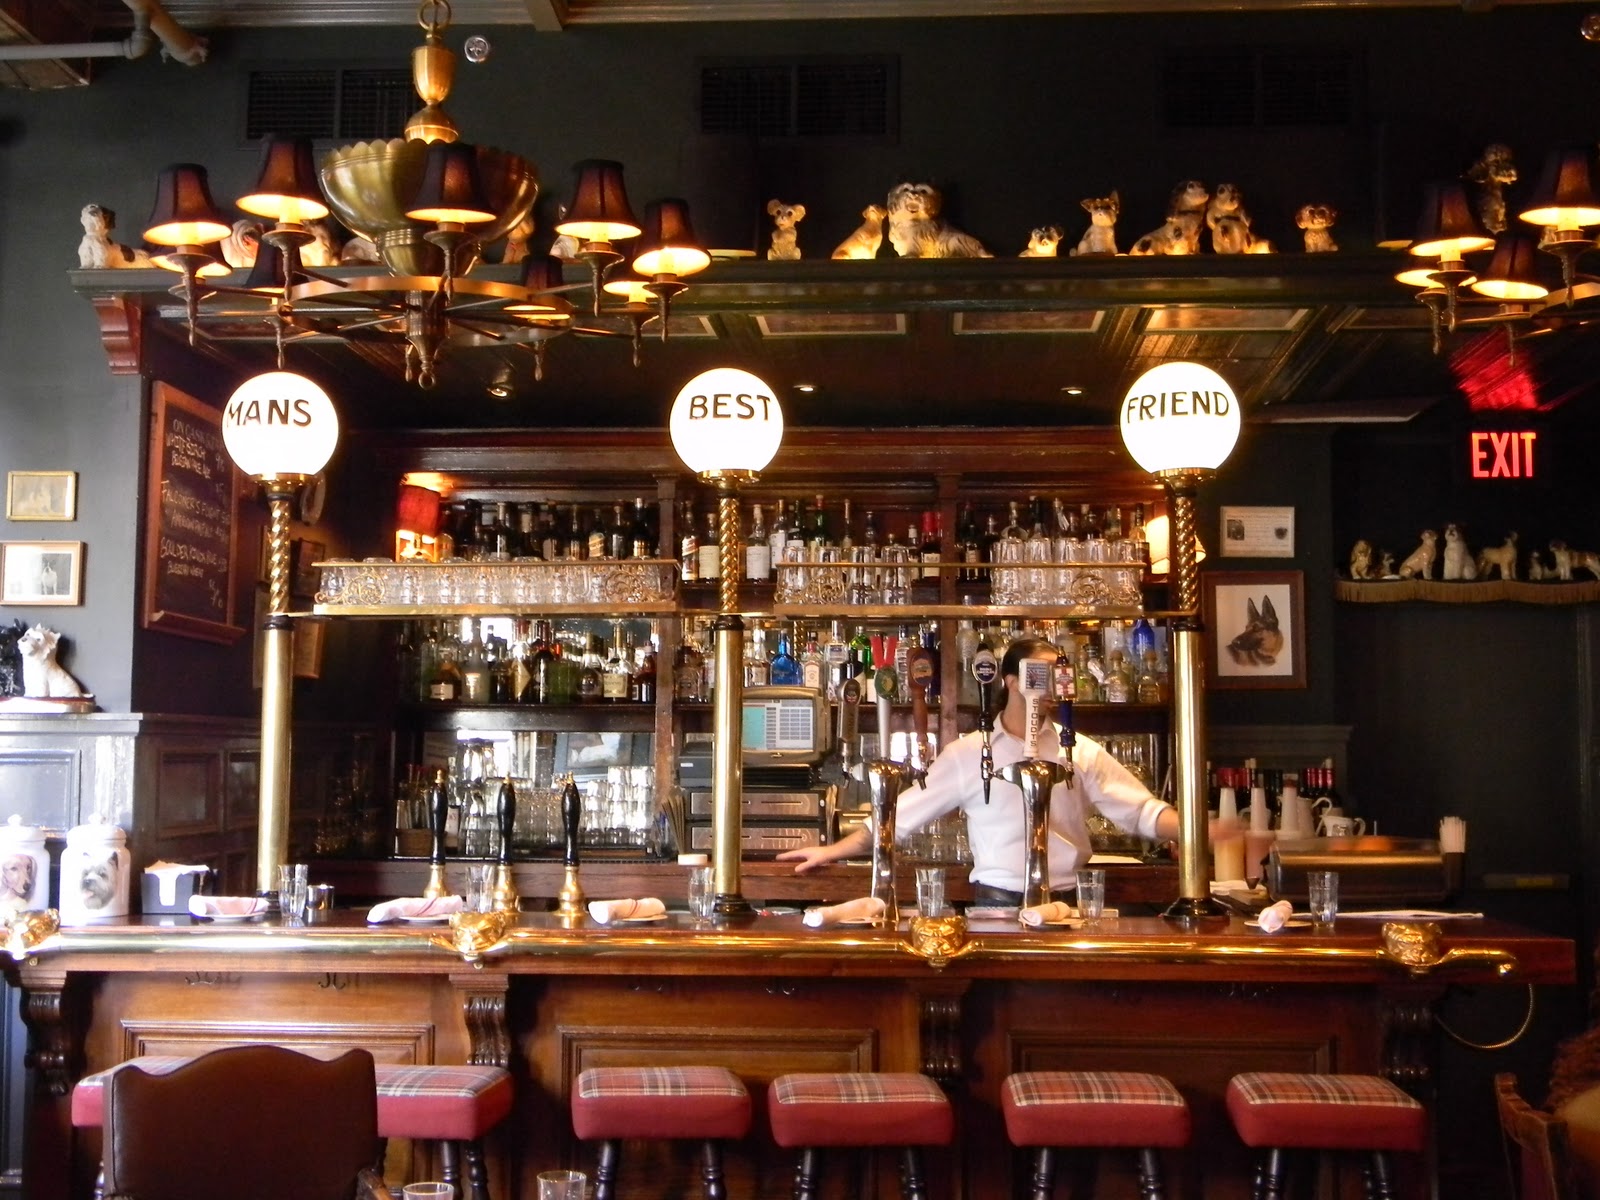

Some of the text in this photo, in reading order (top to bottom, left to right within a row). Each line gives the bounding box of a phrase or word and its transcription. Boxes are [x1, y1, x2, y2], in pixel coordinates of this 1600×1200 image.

[226, 399, 312, 428] MANS
[689, 393, 771, 421] BEST
[1127, 391, 1229, 424] FRIEND
[1471, 432, 1537, 478] EXIT
